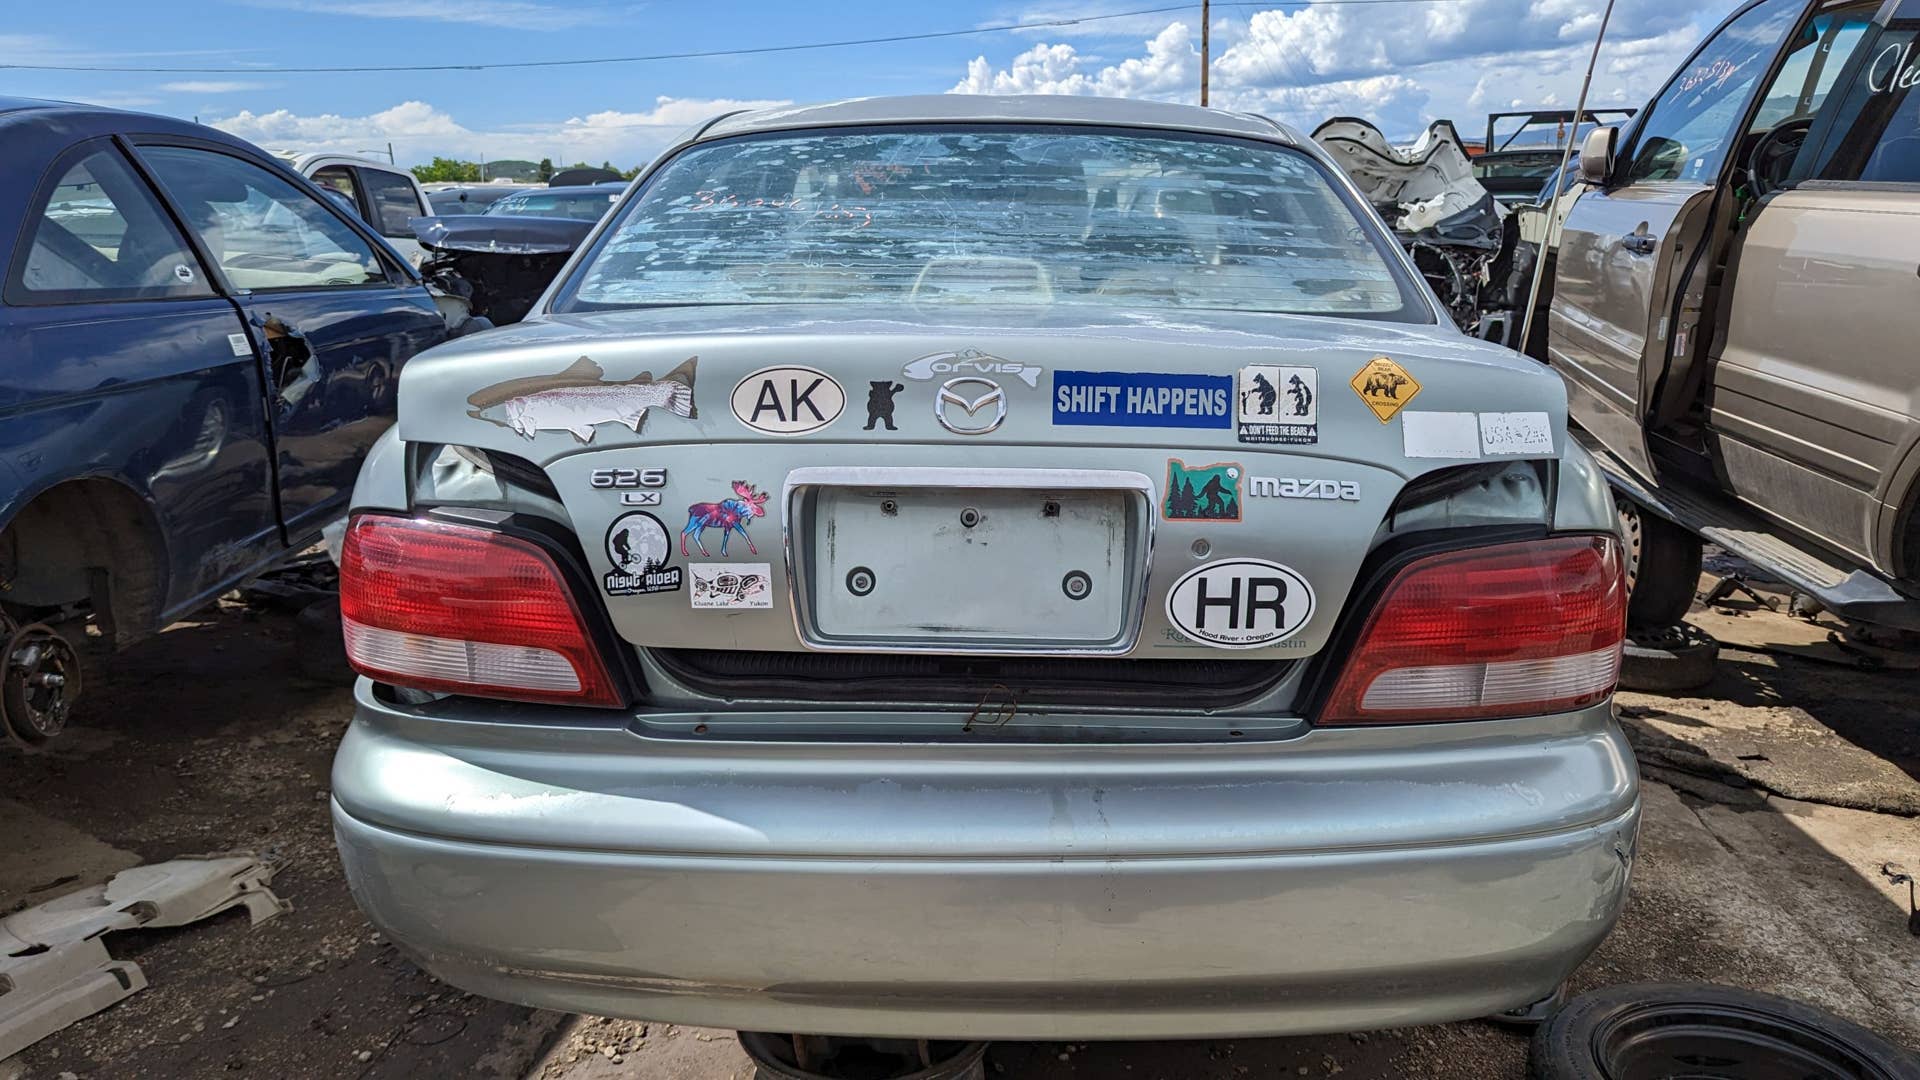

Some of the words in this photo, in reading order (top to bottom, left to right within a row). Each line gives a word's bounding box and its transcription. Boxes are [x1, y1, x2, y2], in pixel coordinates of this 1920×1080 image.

[750, 378, 826, 422] AK
[1057, 385, 1121, 414] SHIFT
[1127, 386, 1227, 417] HAPPENS
[1248, 425, 1264, 435] DON'T
[1266, 425, 1279, 435] FEED
[1280, 426, 1290, 436] THE
[1291, 426, 1308, 436] BEARS
[590, 468, 667, 488] 626
[624, 493, 656, 503] LX
[1196, 577, 1288, 629] HR
[1198, 628, 1218, 639] Hood
[1245, 631, 1274, 641] Oregon
